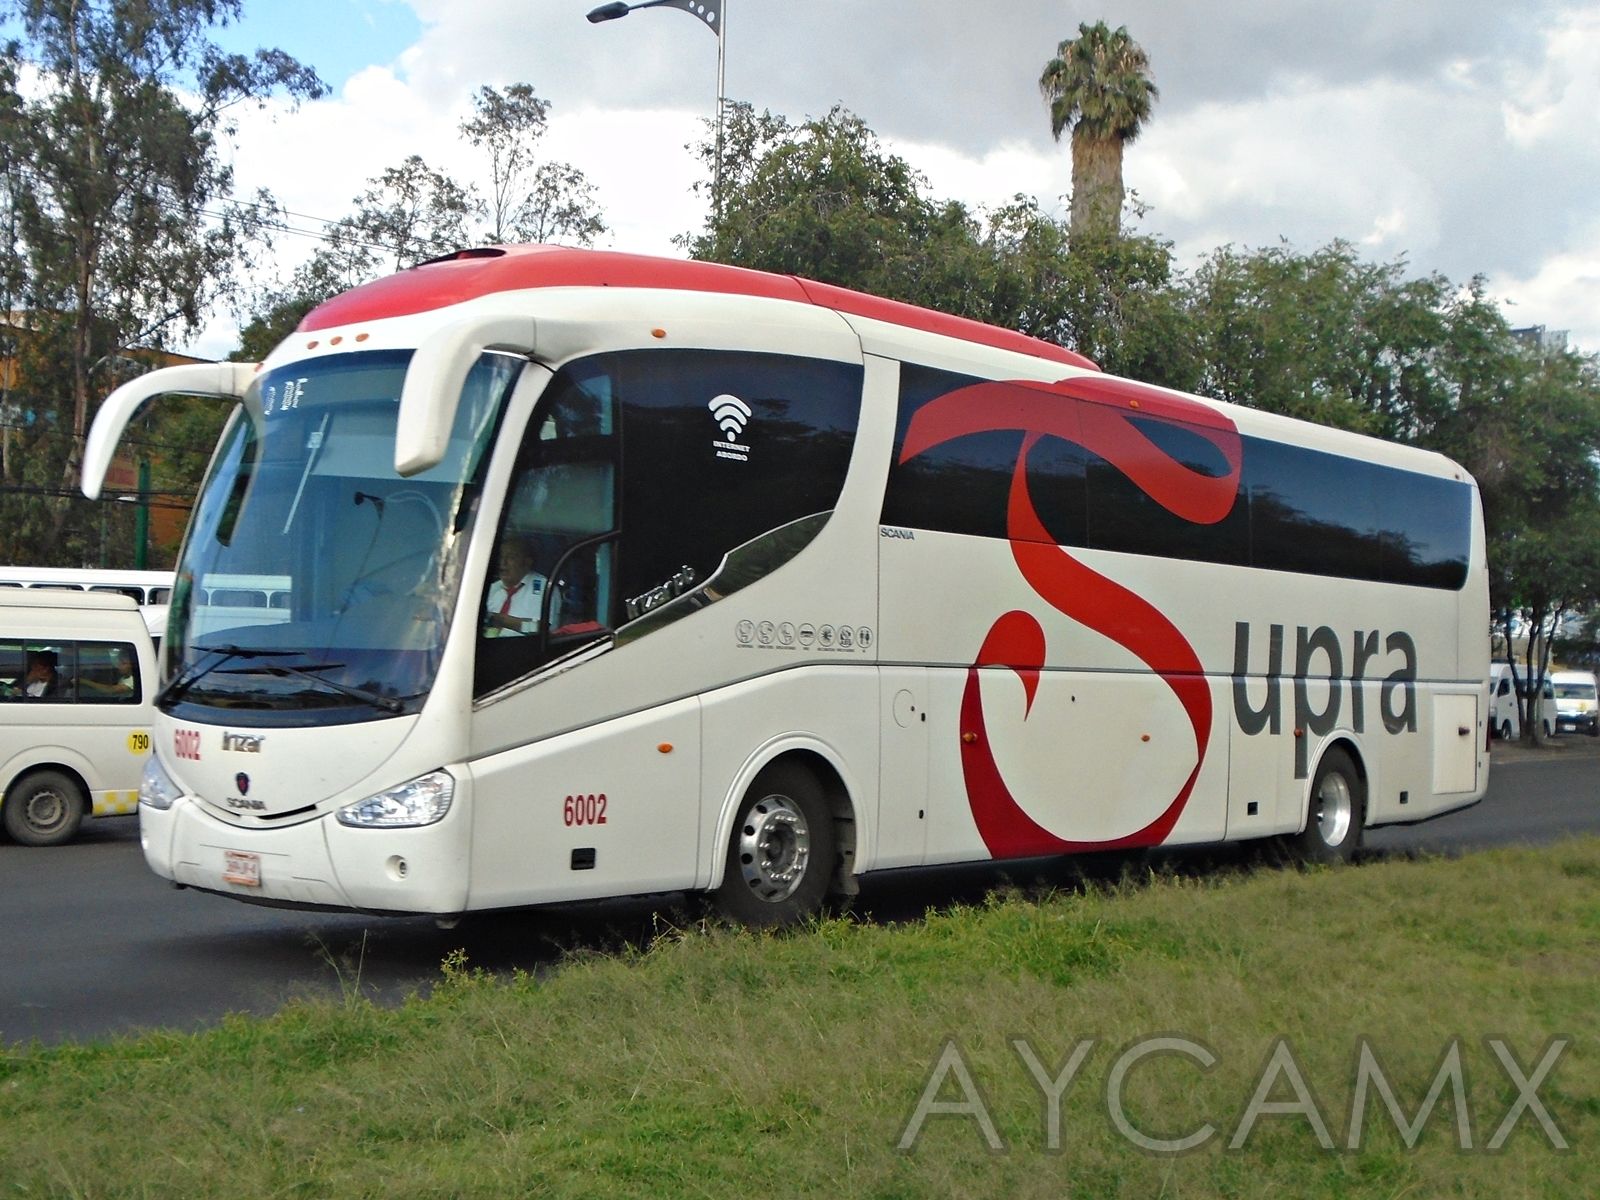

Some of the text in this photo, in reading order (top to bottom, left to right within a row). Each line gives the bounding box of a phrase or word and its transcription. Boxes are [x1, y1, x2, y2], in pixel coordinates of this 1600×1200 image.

[712, 440, 751, 453] INTERNET
[716, 450, 748, 462] ABORDO
[880, 527, 915, 541] SCANIA
[132, 734, 149, 750] 790
[174, 729, 201, 761] 6002
[227, 797, 268, 811] SCANIA
[564, 793, 607, 827] 6002
